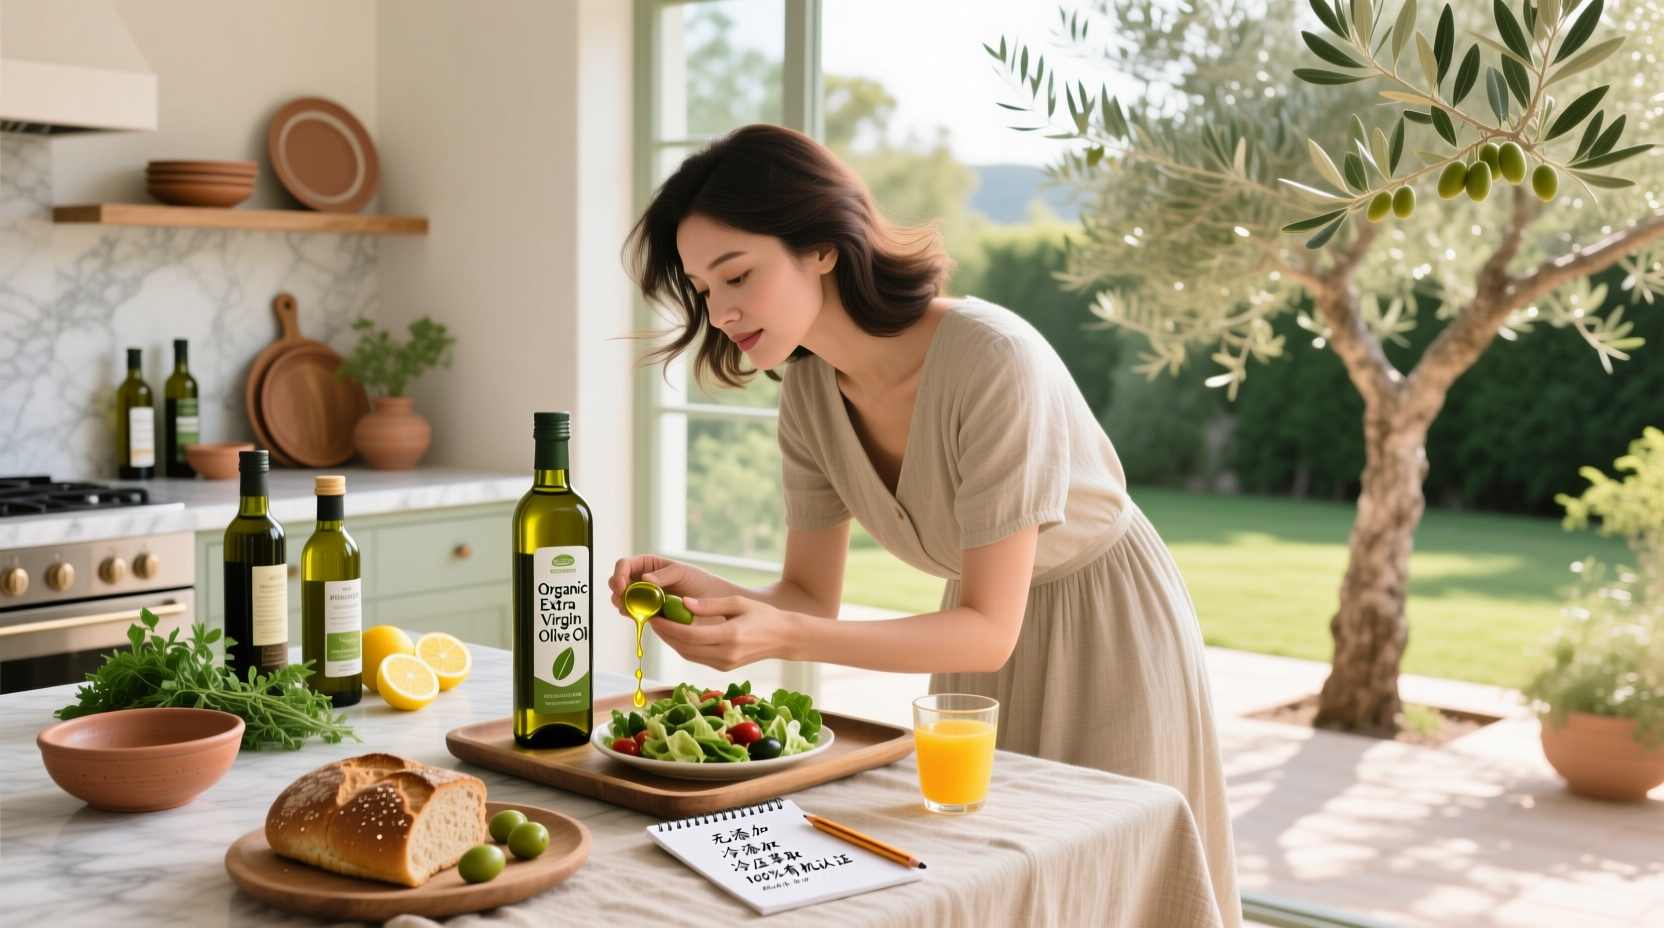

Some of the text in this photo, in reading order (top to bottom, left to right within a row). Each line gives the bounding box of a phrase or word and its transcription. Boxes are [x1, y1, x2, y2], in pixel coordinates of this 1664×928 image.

[538, 581, 588, 599] Organic
[540, 598, 576, 611] Extra
[541, 612, 582, 630] Virgin
[712, 824, 769, 845] 无添加
